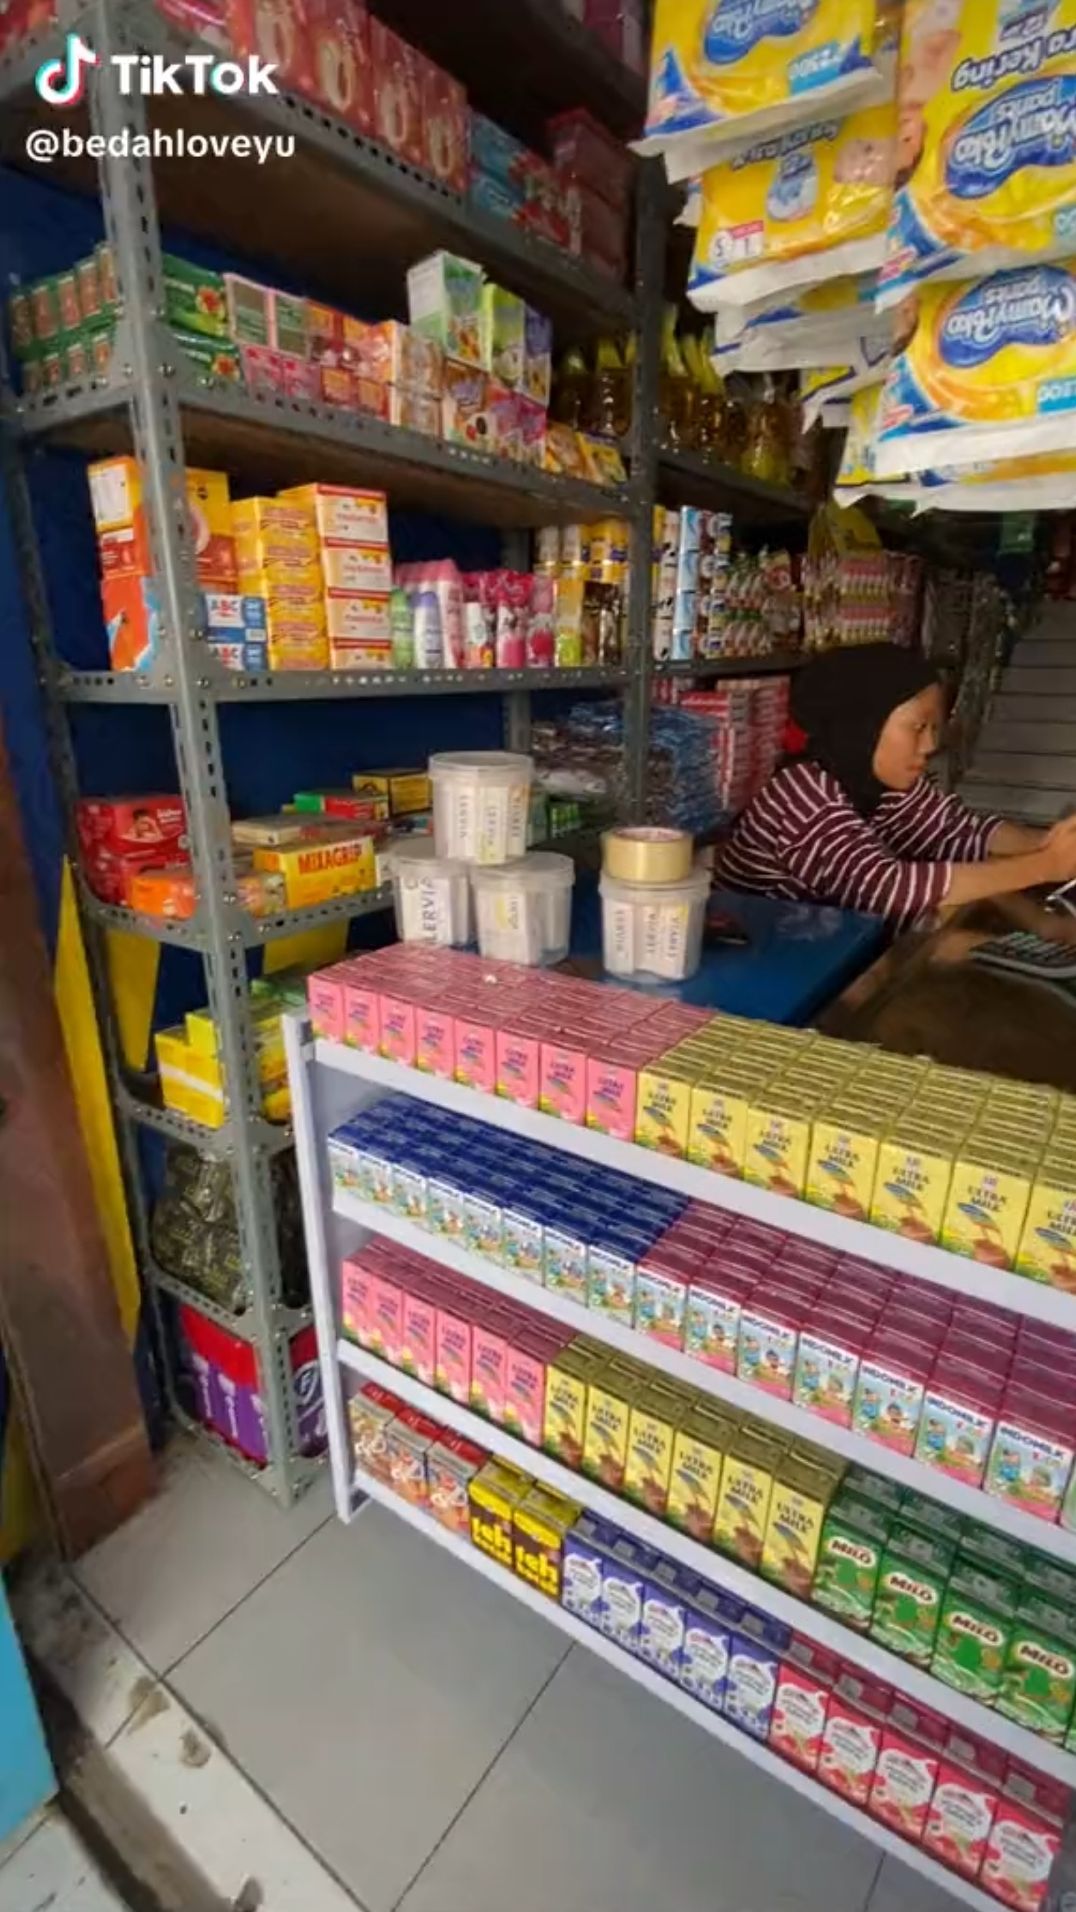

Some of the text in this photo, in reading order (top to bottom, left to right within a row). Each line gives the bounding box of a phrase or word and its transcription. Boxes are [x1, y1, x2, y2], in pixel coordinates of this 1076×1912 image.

[953, 38, 1042, 91] Kering
[297, 842, 363, 875] MIXAGRIP
[831, 1538, 873, 1566] MILO
[889, 1575, 934, 1603] MILO
[951, 1614, 1000, 1644] MILO
[1019, 1644, 1070, 1677] MILO
